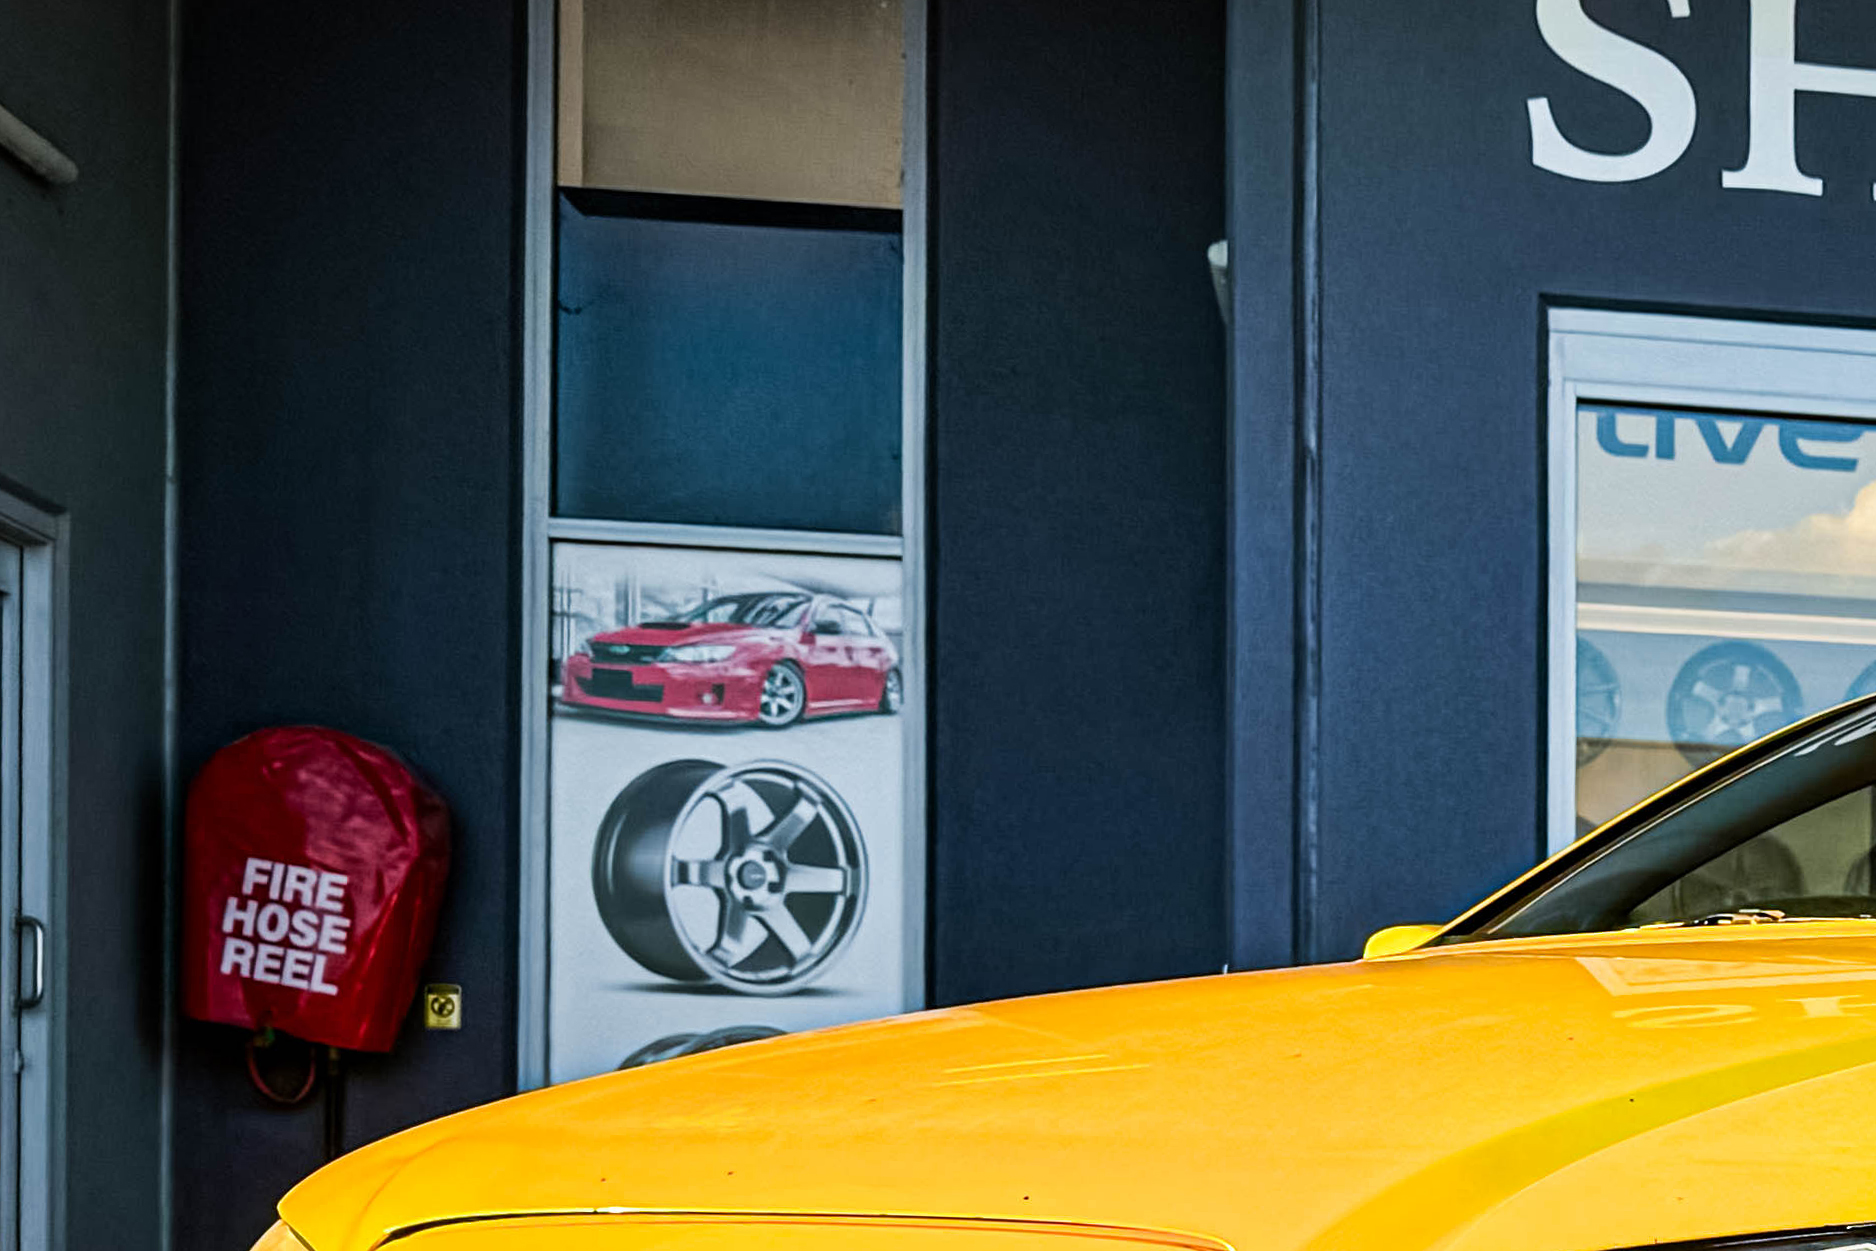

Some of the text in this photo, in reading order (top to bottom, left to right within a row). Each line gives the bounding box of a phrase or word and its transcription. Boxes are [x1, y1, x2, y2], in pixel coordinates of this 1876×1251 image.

[242, 857, 349, 913] FIRE
[222, 897, 351, 955] HOSE
[220, 938, 338, 995] REEL
